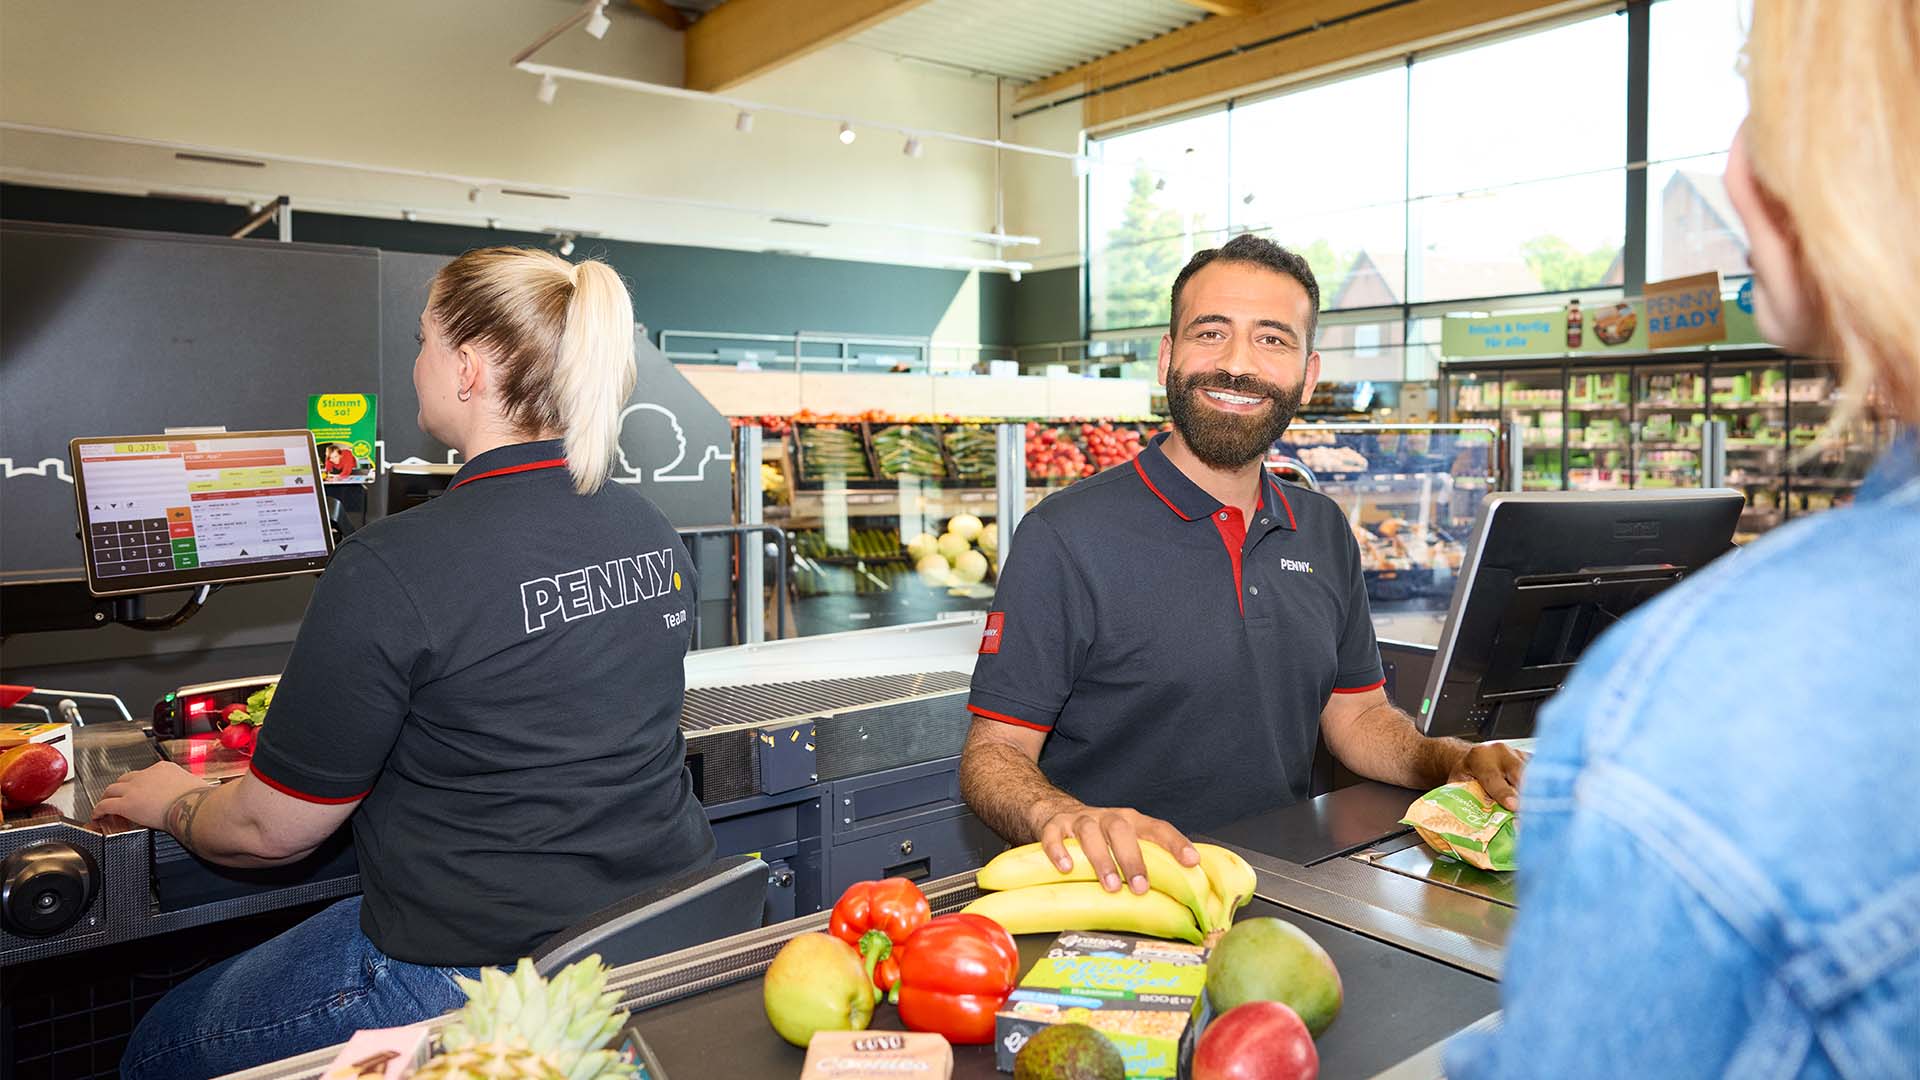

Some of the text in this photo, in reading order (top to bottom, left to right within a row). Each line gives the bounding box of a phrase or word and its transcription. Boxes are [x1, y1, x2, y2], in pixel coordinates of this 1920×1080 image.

[1650, 307, 1720, 333] READY
[322, 398, 361, 408] Stimmt
[334, 408, 351, 416] so!
[663, 609, 687, 629] Team
